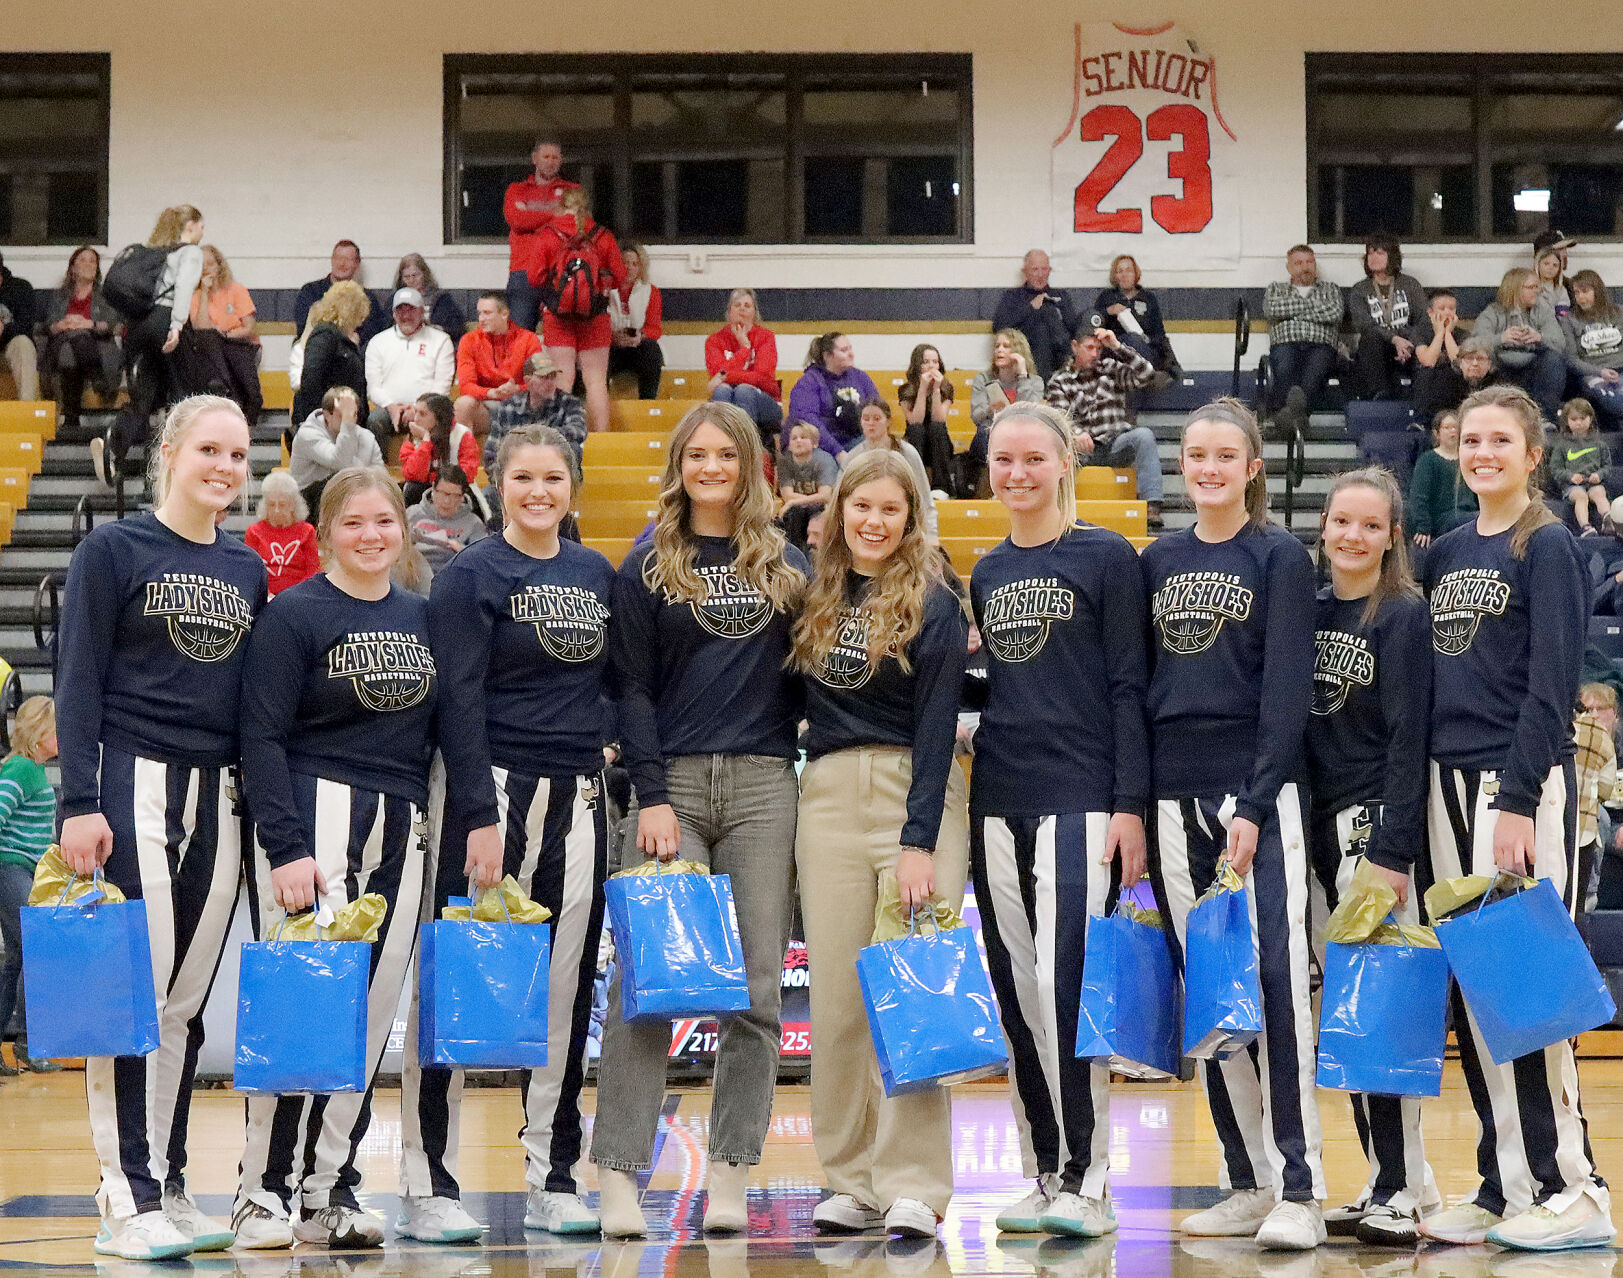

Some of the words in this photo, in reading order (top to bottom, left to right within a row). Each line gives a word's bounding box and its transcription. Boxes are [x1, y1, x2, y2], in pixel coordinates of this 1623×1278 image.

[1082, 50, 1210, 99] SENIOR
[1073, 104, 1213, 234] 23
[418, 344, 427, 356] E
[692, 566, 737, 575] EUTOP
[1166, 571, 1241, 586] TEUTOPOLIS
[1440, 568, 1500, 583] TEUTOPOLIS
[163, 573, 240, 595] TEUTOPOLIS
[525, 584, 597, 600] TEUTOPOLIS
[991, 577, 1058, 598] TEUTOPOLIS
[144, 582, 198, 616] LADY
[1013, 587, 1074, 620] SHOES
[1185, 580, 1254, 622] SHOES
[1455, 578, 1511, 616] SHOES
[510, 592, 563, 622] LADY
[1433, 610, 1475, 622] BASKETBALL
[178, 614, 235, 632] BASKETBALL
[545, 620, 599, 632] BASKETBALL
[991, 618, 1041, 633] BASKETBALL
[347, 631, 418, 643] TEUTOPOLIS
[1314, 630, 1367, 649] UTOPOLIS
[328, 641, 383, 678] LADY
[829, 646, 868, 661] KETBALL
[1320, 641, 1375, 686] SHOES
[364, 672, 421, 682] BASKETBALL
[1313, 672, 1342, 686] KETBALL
[688, 1032, 718, 1051] 217
[780, 1032, 811, 1050] 25
